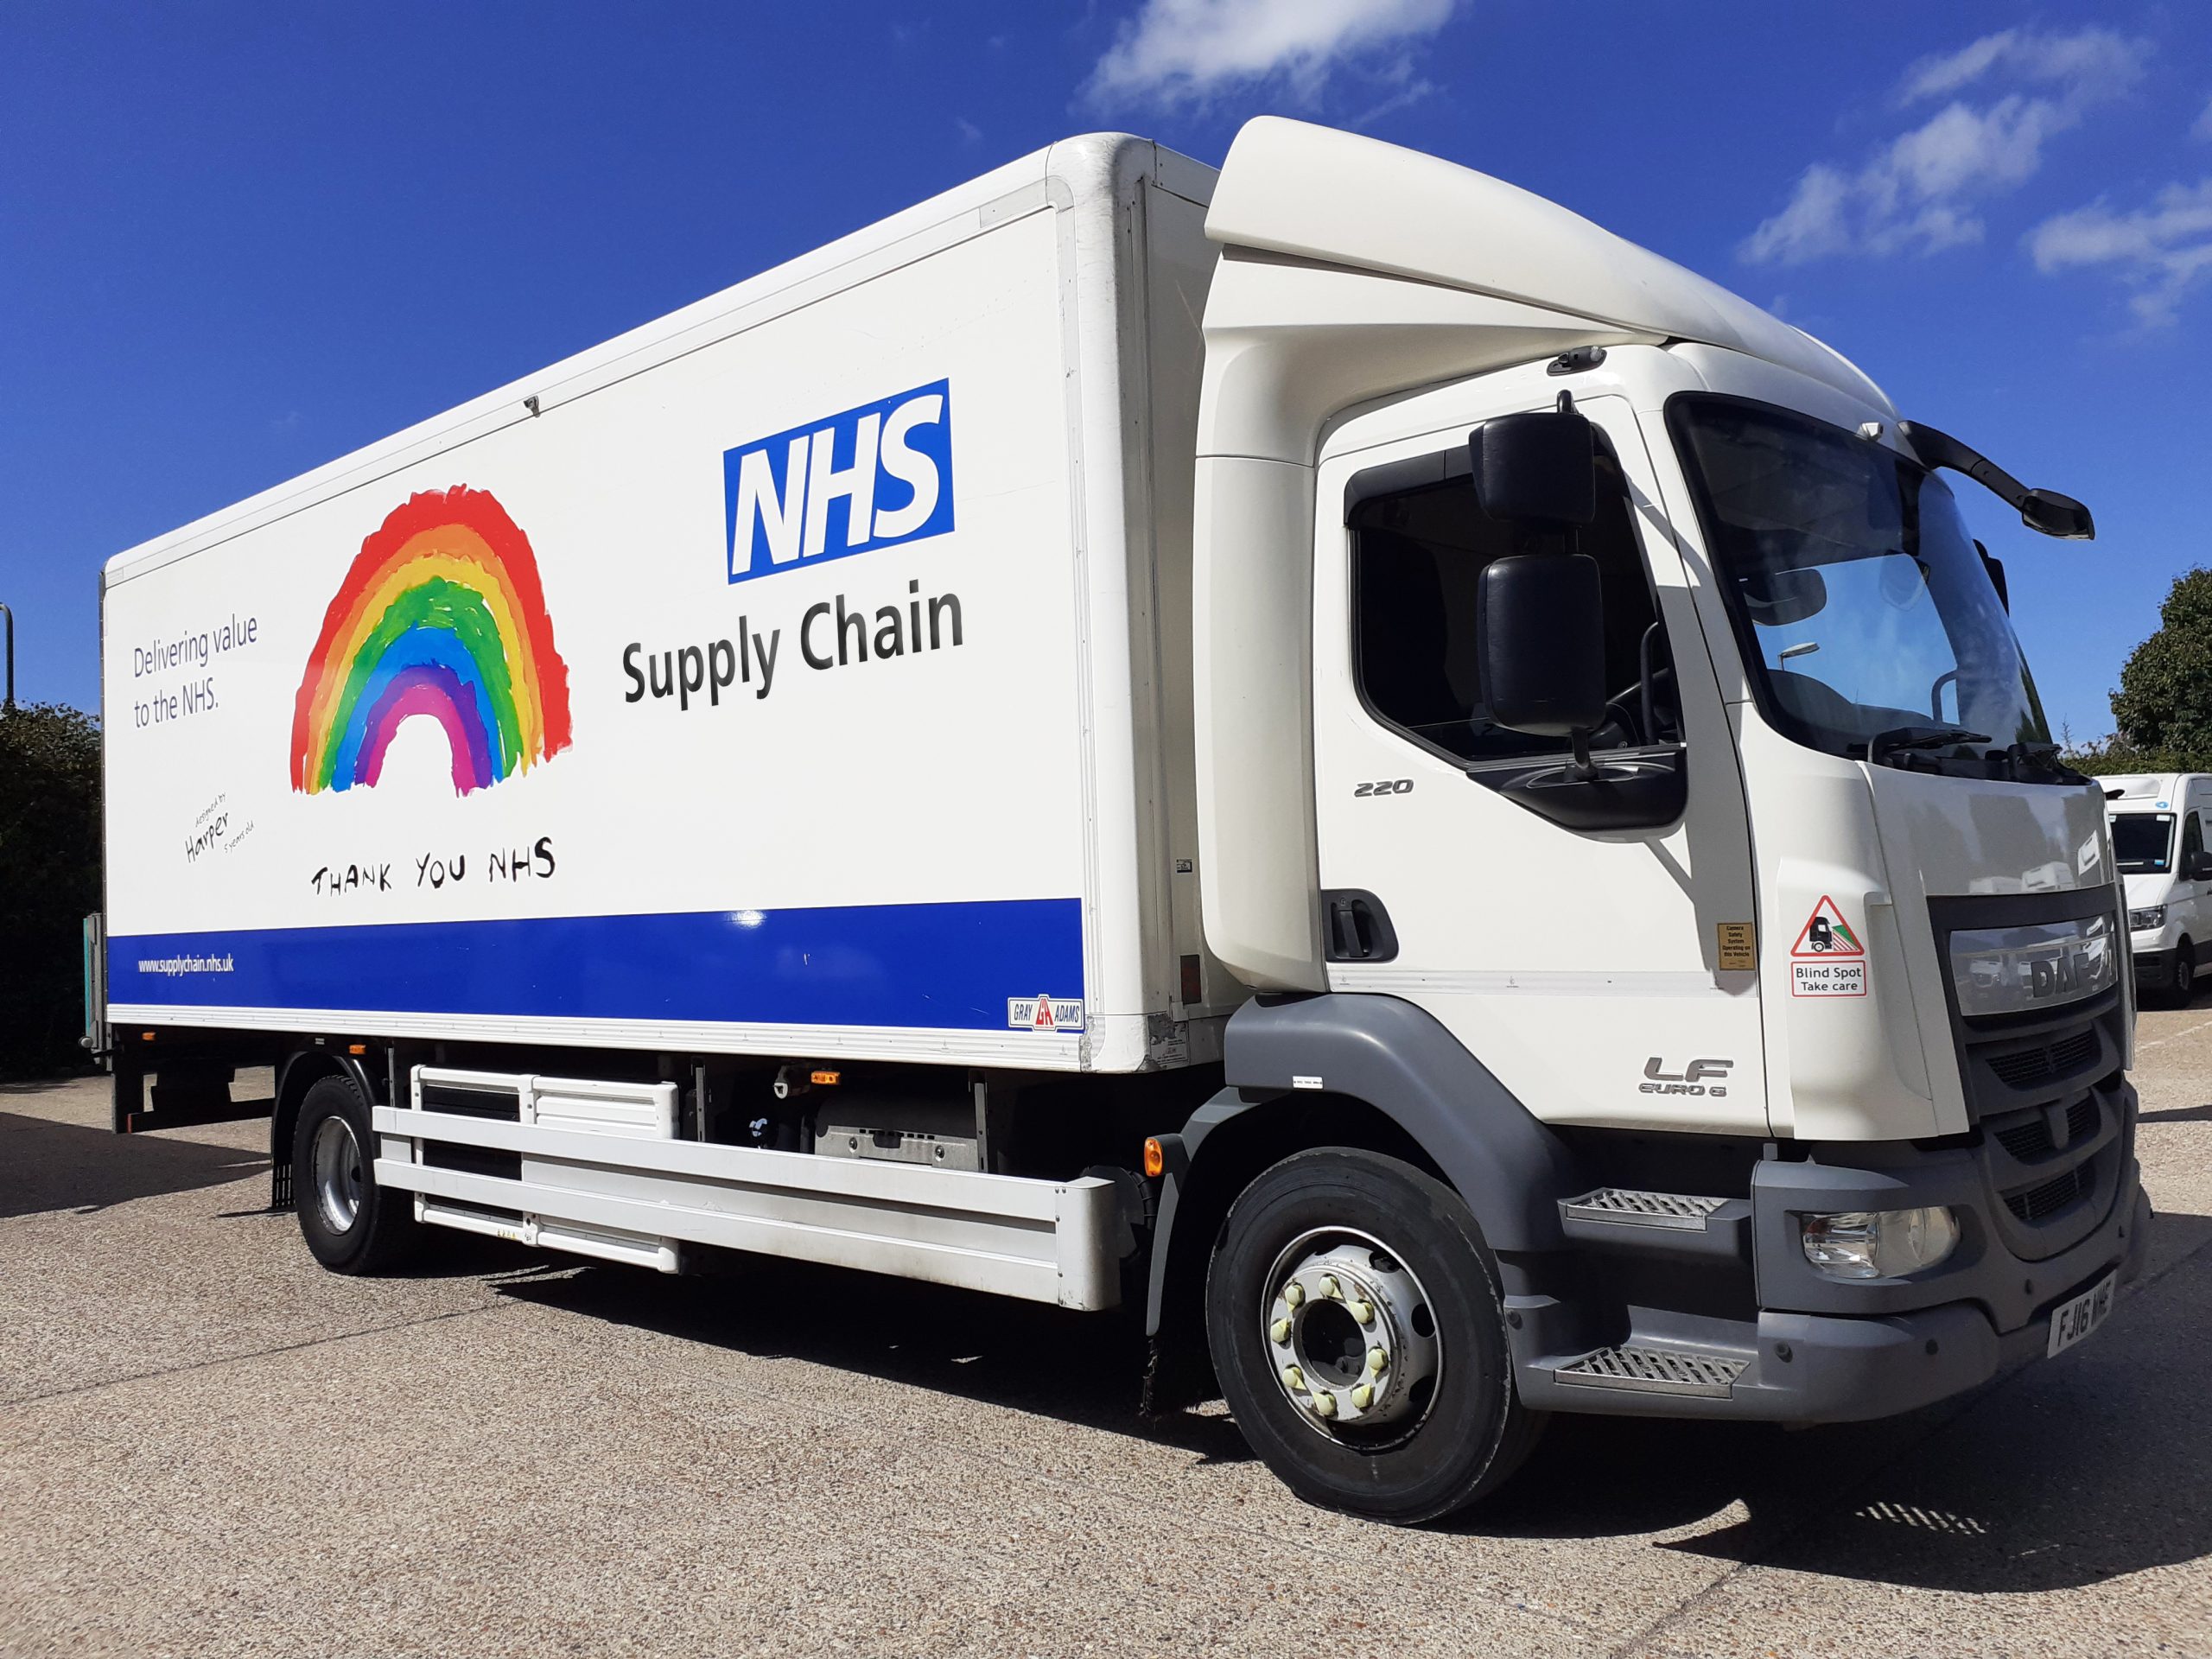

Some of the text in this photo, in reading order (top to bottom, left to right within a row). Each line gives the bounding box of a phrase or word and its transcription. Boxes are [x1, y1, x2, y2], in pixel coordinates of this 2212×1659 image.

[732, 394, 944, 575] NHS
[134, 613, 257, 678] Delivering value
[622, 579, 963, 711] Supply Chain
[134, 677, 219, 728] to the NHS.
[1353, 779, 1414, 798] 220
[184, 812, 229, 863] Harper
[311, 836, 556, 897] THANK YOU NHS
[138, 952, 234, 976] www.supplychain.nhs.uk
[1796, 967, 1862, 980] Blind Spot
[1801, 981, 1858, 991] Take care
[2031, 950, 2090, 999] DAF
[1014, 1003, 1033, 1021] GRAY
[1054, 1004, 1080, 1023] ADAMS
[1643, 1057, 1734, 1082] LF
[2057, 1298, 2091, 1347] FJ16
